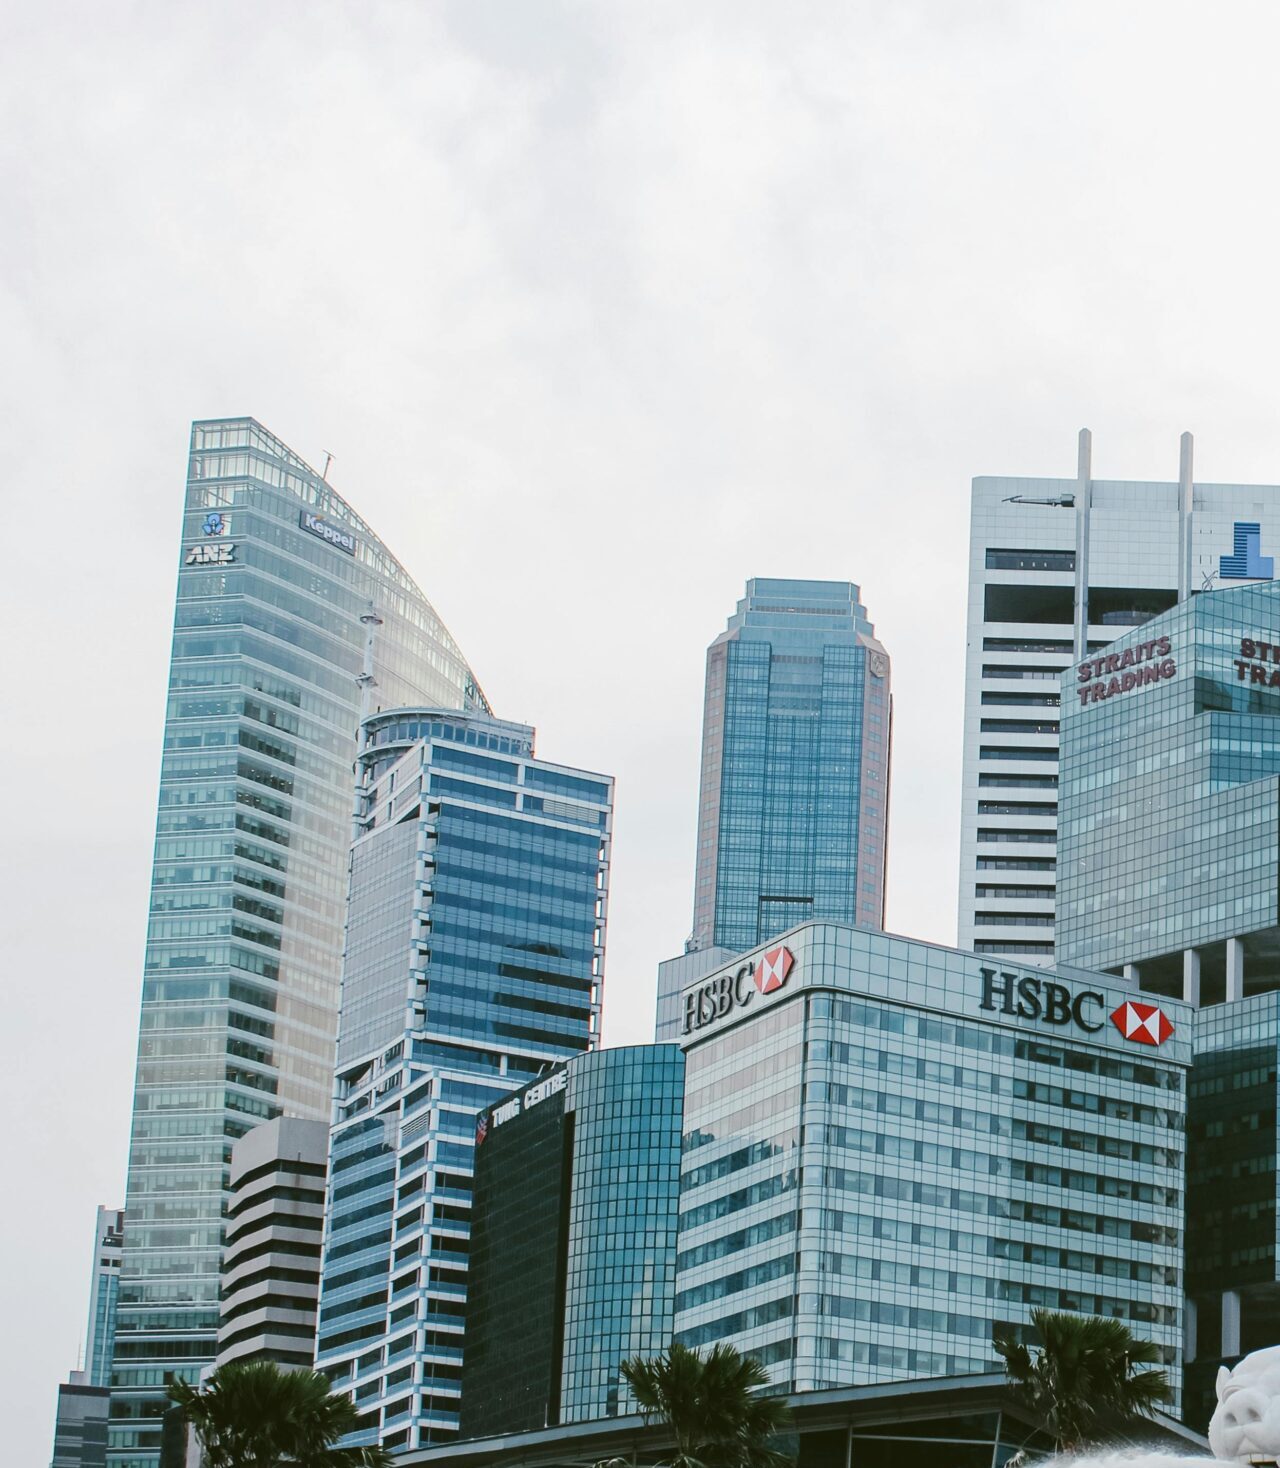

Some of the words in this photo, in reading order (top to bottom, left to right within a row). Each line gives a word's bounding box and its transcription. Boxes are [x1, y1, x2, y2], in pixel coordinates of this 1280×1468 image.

[185, 543, 236, 565] ANZ
[305, 513, 354, 551] Keppel
[1077, 635, 1172, 682] STRAITS
[1077, 658, 1177, 706] TRADING
[680, 961, 756, 1035] HSBC
[979, 967, 1105, 1033] HSBC
